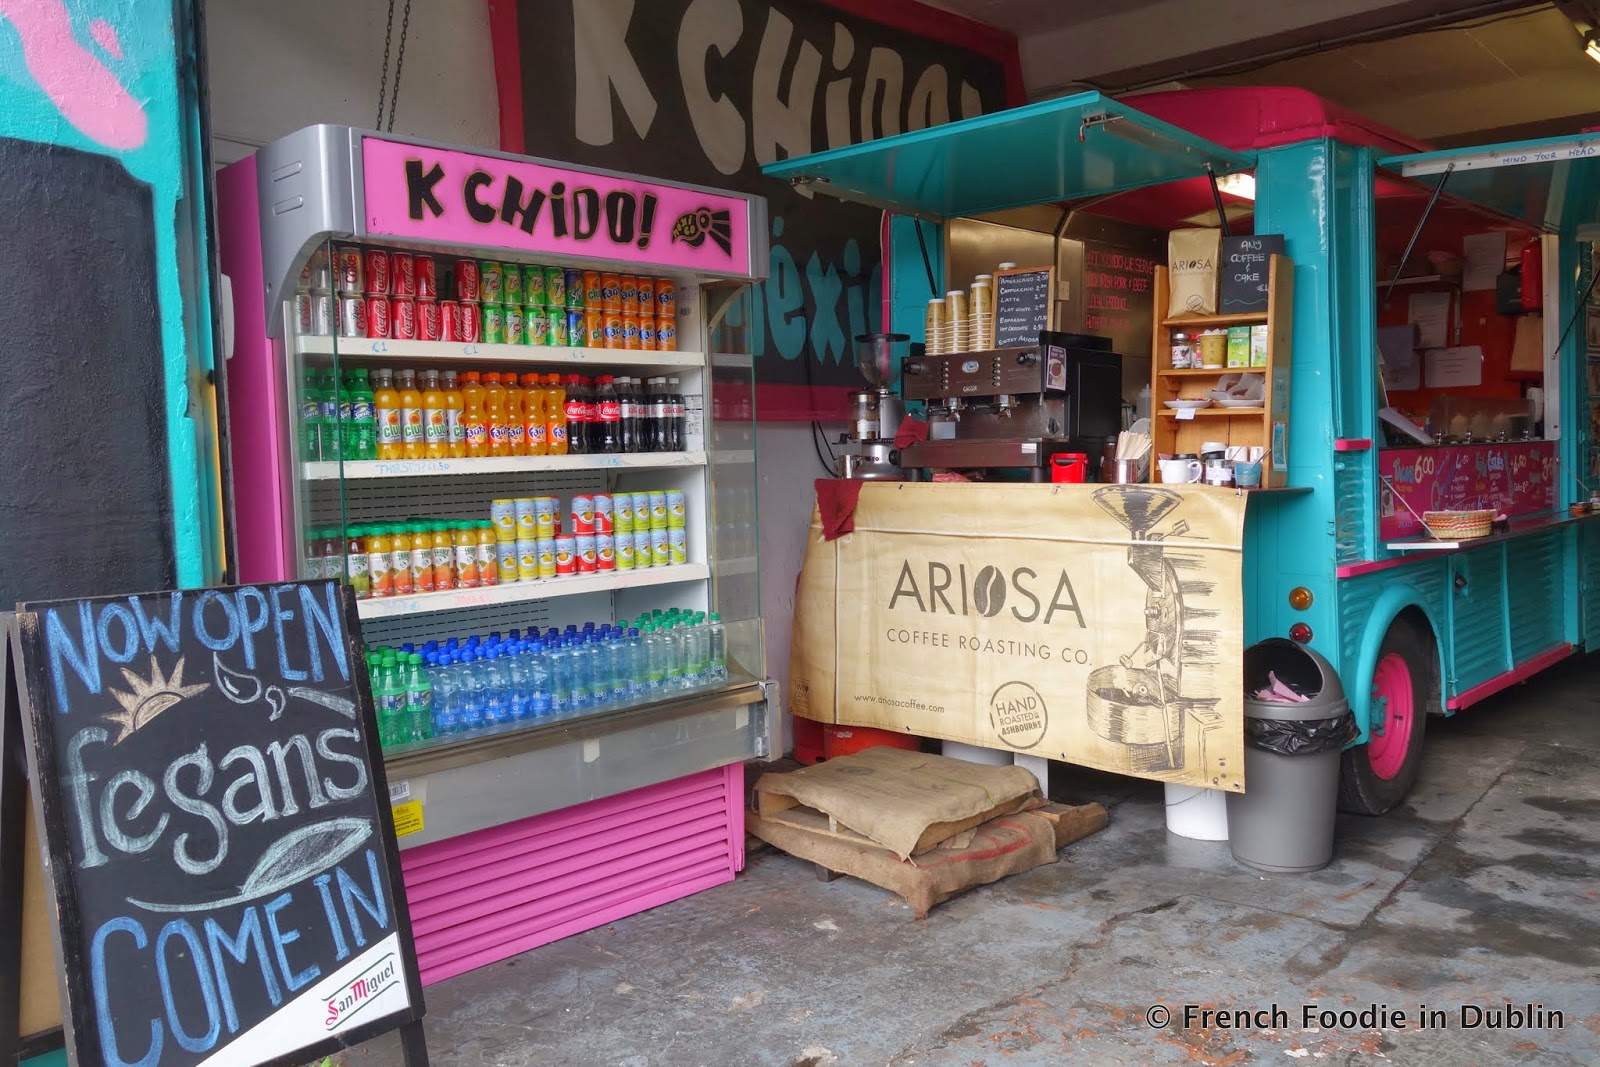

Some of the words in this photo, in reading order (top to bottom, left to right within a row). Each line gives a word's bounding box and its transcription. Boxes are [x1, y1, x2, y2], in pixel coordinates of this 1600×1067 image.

[1503, 155, 1527, 164] MIND
[1534, 152, 1557, 161] YOUR
[1568, 147, 1595, 156] HEAD
[404, 160, 445, 221] K
[1241, 240, 1262, 251] ANY
[1230, 253, 1265, 262] COFFEE
[1234, 273, 1260, 283] CAKE
[888, 559, 1087, 629] ARIOSA
[46, 591, 183, 714] NOW
[193, 582, 350, 683] OPEN
[887, 628, 950, 648] COFFEE
[959, 634, 1052, 660] ROASTING
[1061, 648, 1092, 666] CO.
[854, 694, 945, 714] www.ariosacoffee.com
[996, 696, 1037, 717] HAND
[1000, 712, 1035, 727] ROASTED
[1002, 720, 1042, 736] ASHBOURNE
[65, 727, 371, 874] fegans
[91, 892, 320, 1067] COME
[314, 849, 388, 960] IN
[325, 995, 353, 1026] San
[350, 961, 394, 1001] Miguel
